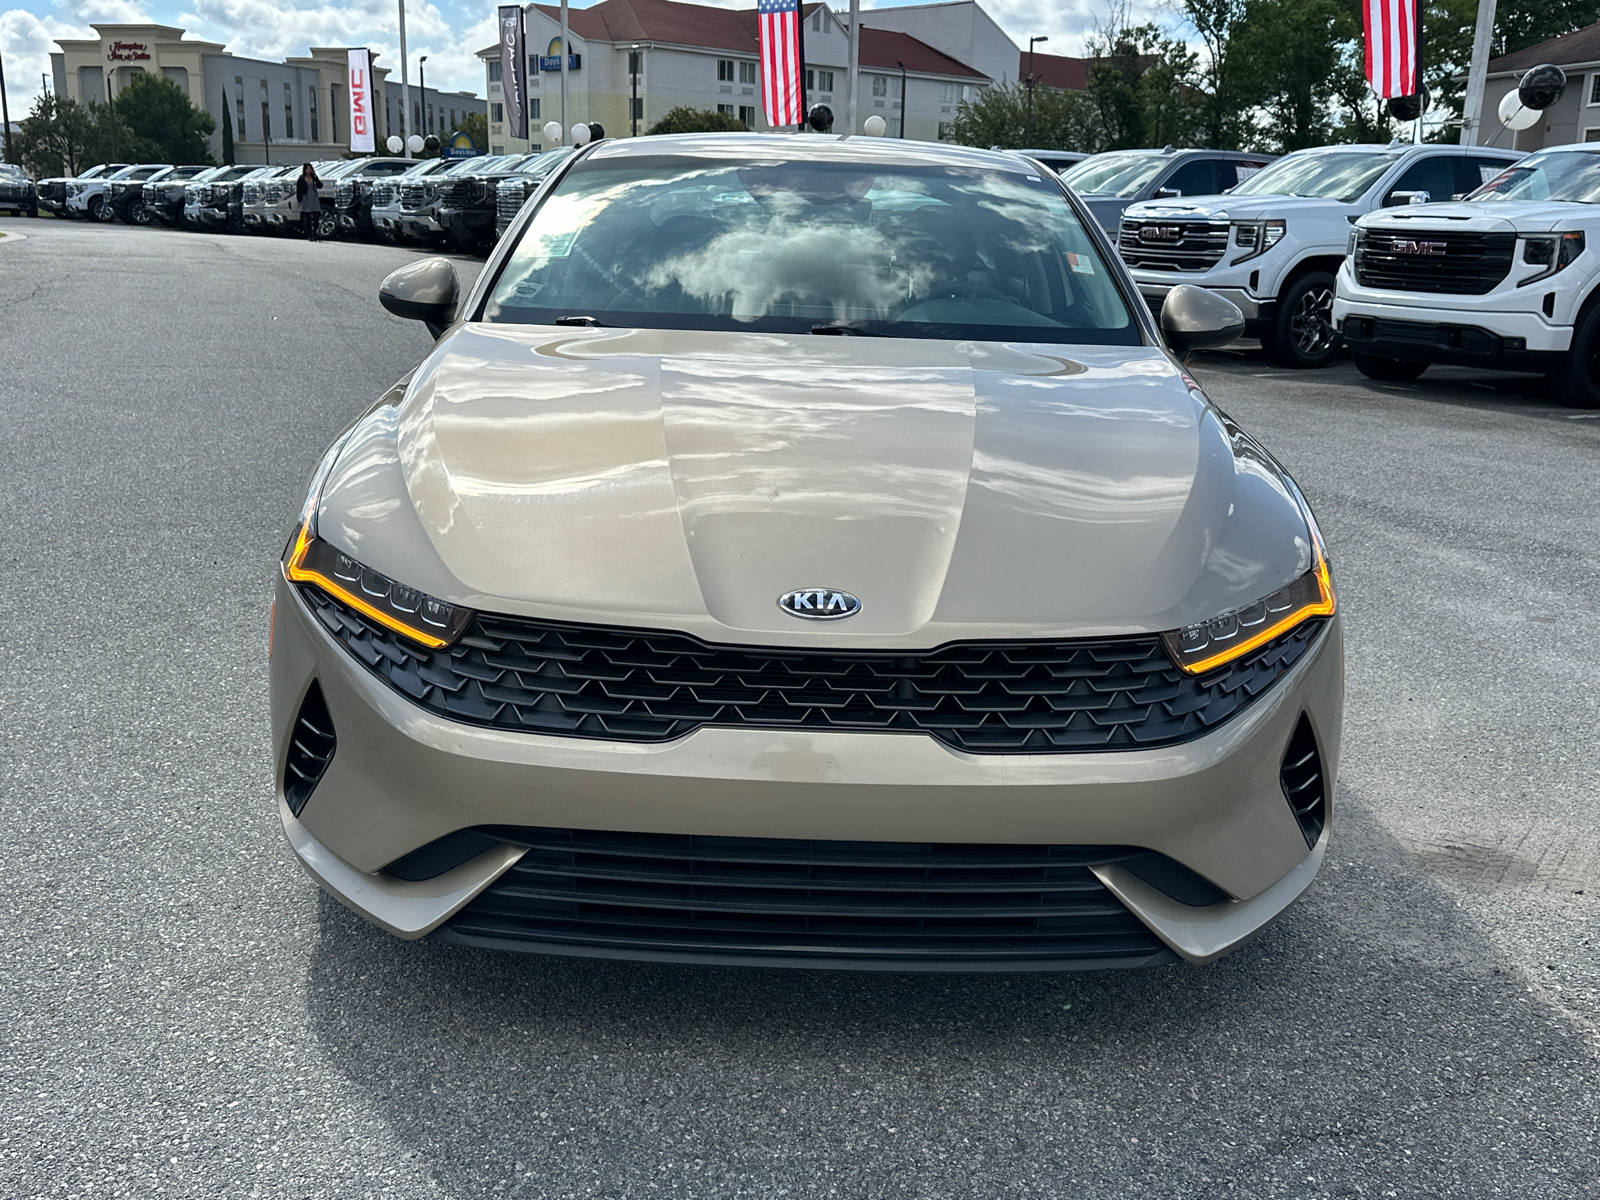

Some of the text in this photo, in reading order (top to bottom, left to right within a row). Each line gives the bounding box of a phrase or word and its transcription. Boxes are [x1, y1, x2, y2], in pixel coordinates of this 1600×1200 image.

[109, 41, 147, 51] Hampton
[107, 51, 125, 61] Inn
[131, 52, 151, 60] Suites
[544, 57, 560, 66] Days
[1140, 226, 1180, 239] GMC
[1391, 240, 1447, 255] GMC
[794, 592, 848, 611] KIA
